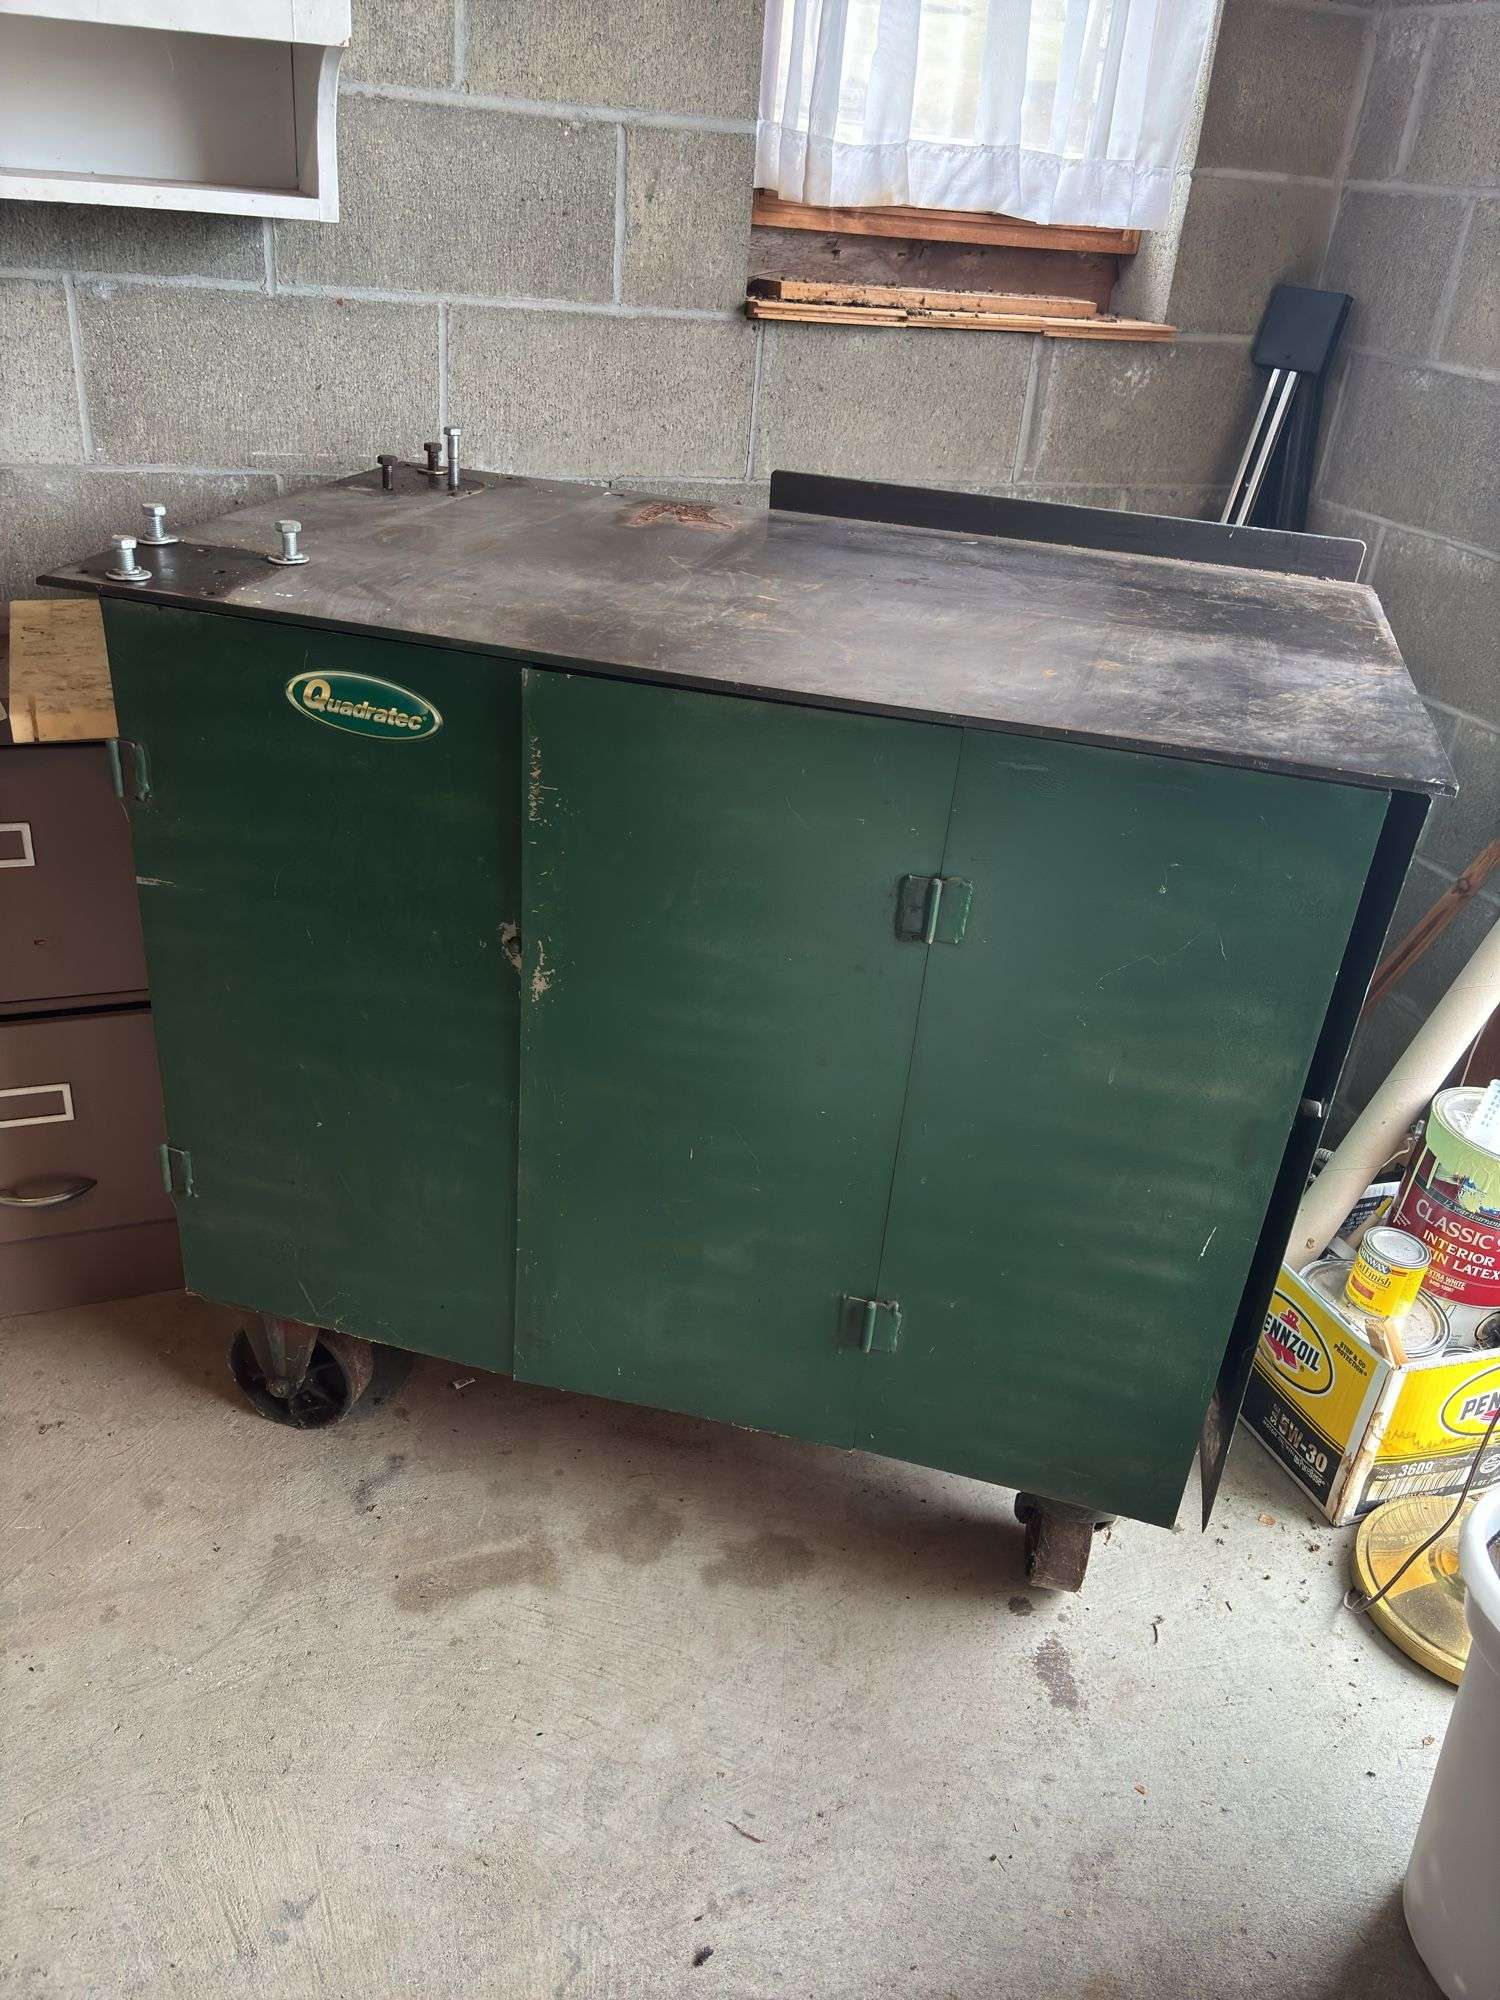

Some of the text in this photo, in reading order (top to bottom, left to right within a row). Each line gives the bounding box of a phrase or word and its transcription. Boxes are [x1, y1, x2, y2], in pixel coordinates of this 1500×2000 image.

[303, 679, 423, 731] Quadratec
[1443, 1199, 1453, 1208] 12
[1453, 1205, 1469, 1217] year
[1416, 1199, 1494, 1250] CLASSIC
[1423, 1229, 1496, 1267] INTERIOR
[1428, 1267, 1445, 1283] XTRA
[1445, 1275, 1466, 1291] WHITE
[1452, 1260, 1500, 1281] LATEX
[1279, 1413, 1328, 1473] 5W-30
[1398, 1460, 1435, 1478] 3609
